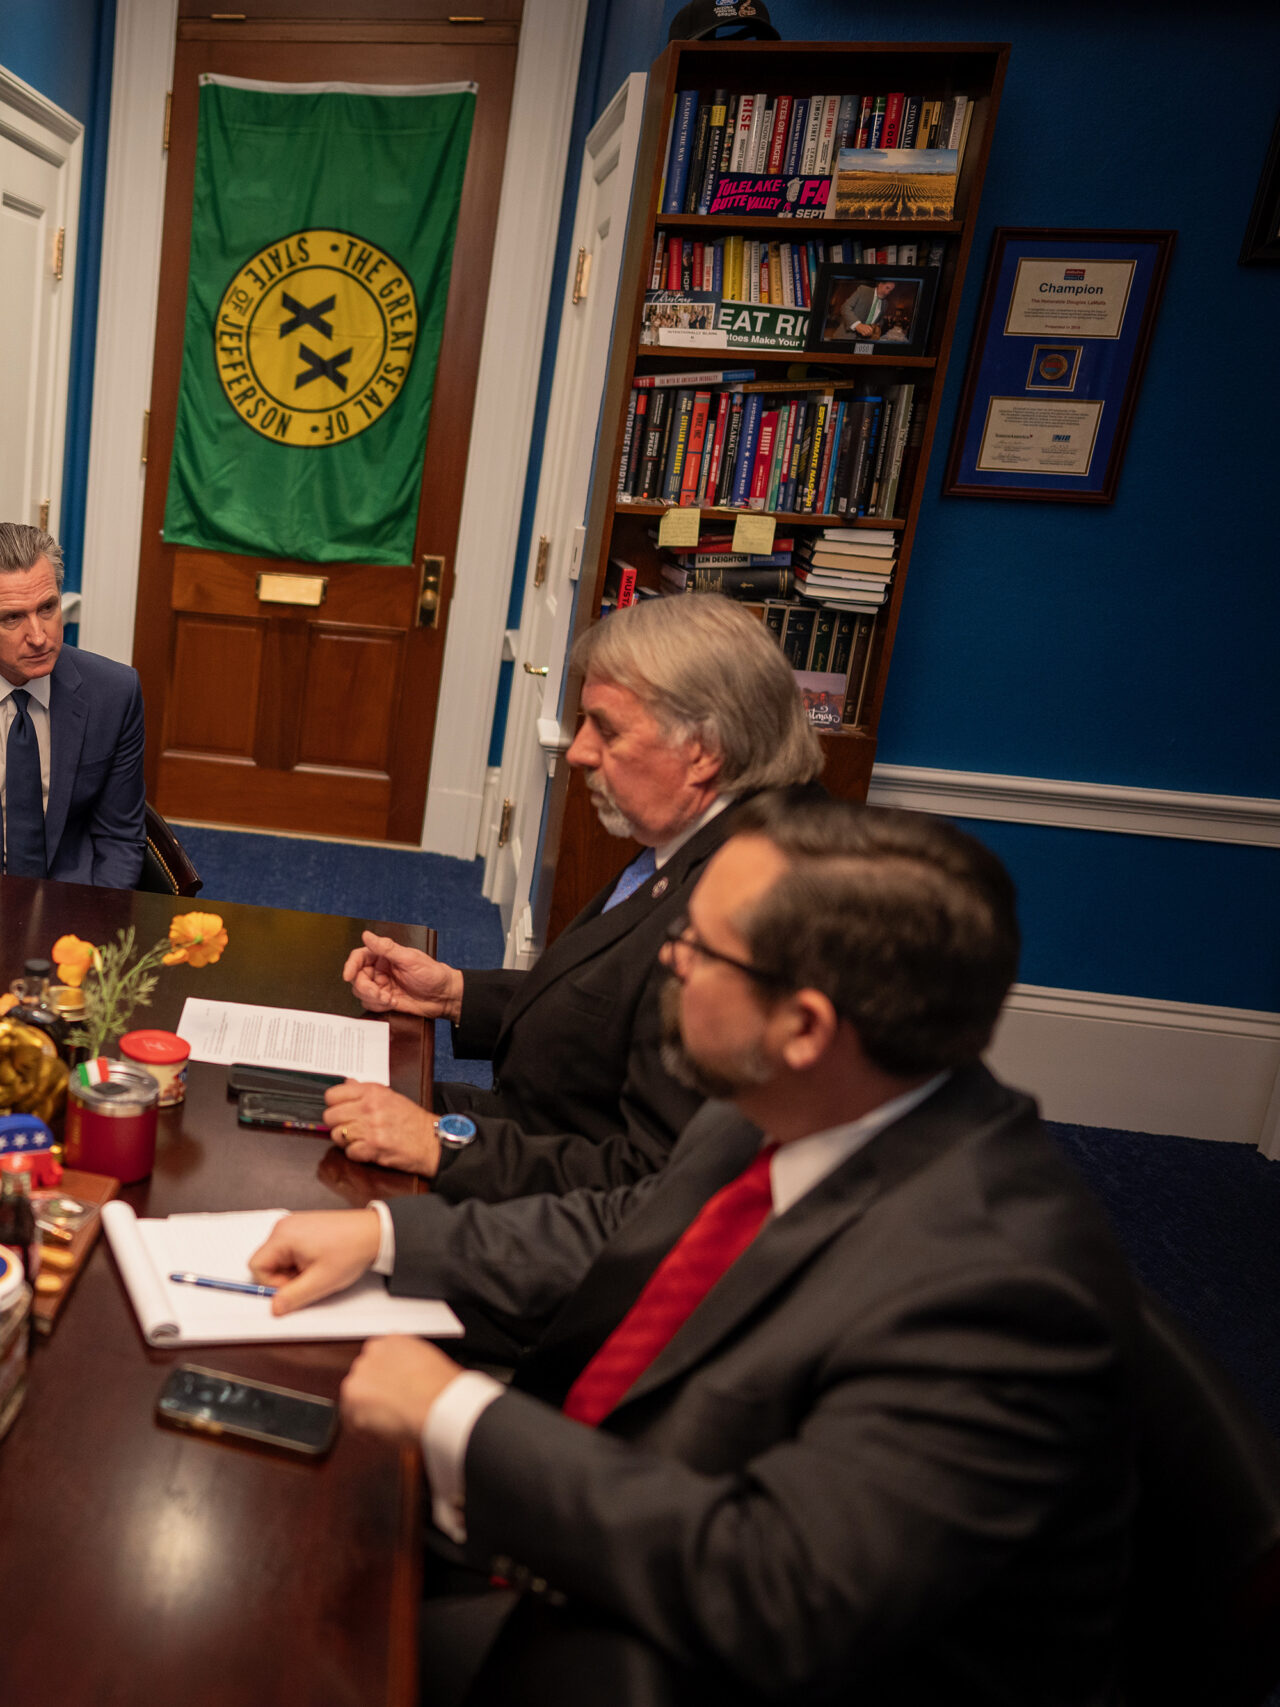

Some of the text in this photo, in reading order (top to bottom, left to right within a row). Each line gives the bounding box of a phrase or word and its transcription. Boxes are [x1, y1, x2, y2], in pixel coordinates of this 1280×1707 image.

[682, 97, 692, 130] LEADING
[740, 99, 754, 131] RISE
[810, 100, 822, 141] SIMON SINEK
[772, 100, 789, 165] EYES ON TARGET
[677, 147, 686, 161] WAY
[706, 174, 714, 205] MOMENT
[710, 194, 748, 213] BUTTE
[746, 196, 782, 211] VALLEY
[1039, 283, 1104, 296] Champion
[219, 236, 310, 438] STATE OF JEFFERSON
[324, 239, 414, 440] THE GREAT SEAL OF
[751, 335, 776, 345] Make
[778, 338, 800, 347] Your
[646, 432, 655, 456] SPREAD
[678, 415, 688, 442] CIVILIAN
[727, 413, 740, 456] BREAKOUT
[673, 444, 684, 474] WARRIORS
[811, 427, 822, 468] ULTIMATE
[806, 470, 816, 507] NASCAR
